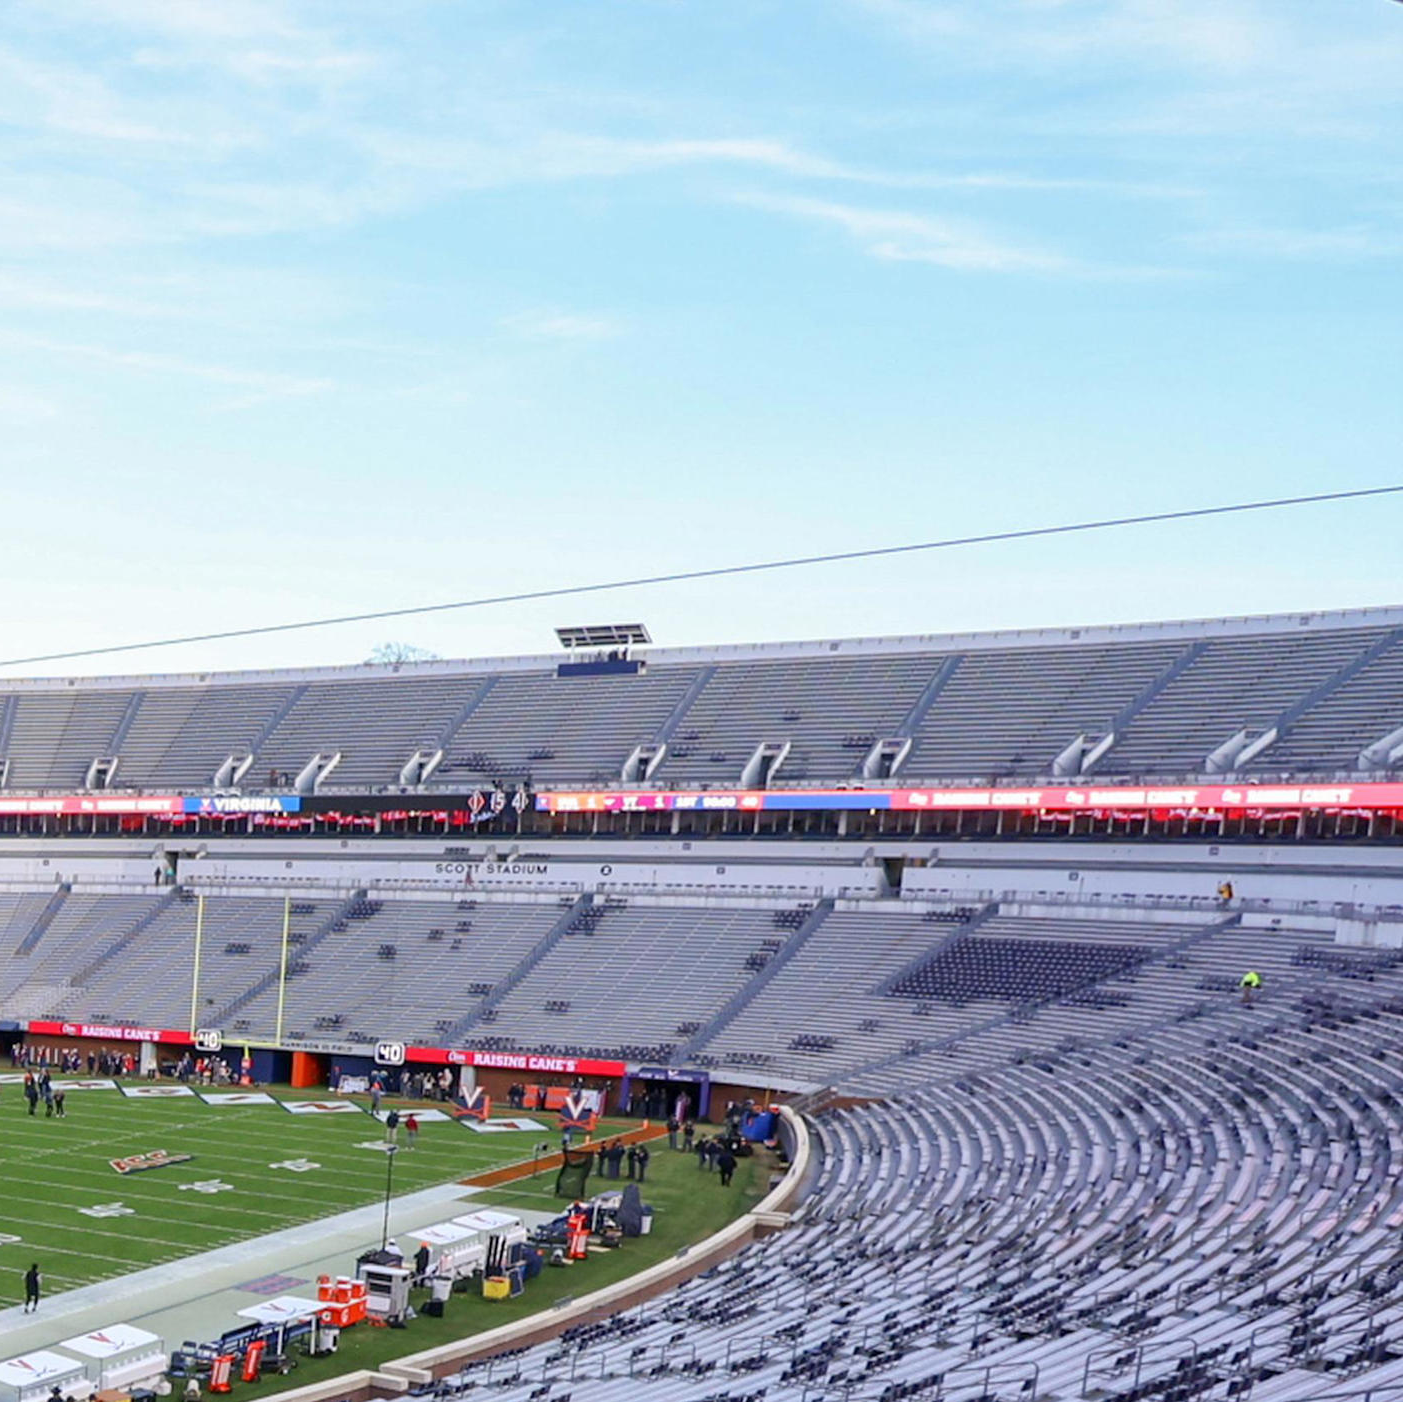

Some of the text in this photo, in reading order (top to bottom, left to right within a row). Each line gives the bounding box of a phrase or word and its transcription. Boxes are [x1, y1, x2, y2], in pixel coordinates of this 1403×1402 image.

[213, 798, 284, 812] VIRGINIA
[436, 863, 548, 874] SCOTT STADIUM
[80, 1025, 122, 1038] RAISING
[202, 1031, 218, 1048] 40
[379, 1045, 402, 1061] 40
[472, 1053, 527, 1068] RAISING
[529, 1057, 579, 1071] CANE'S
